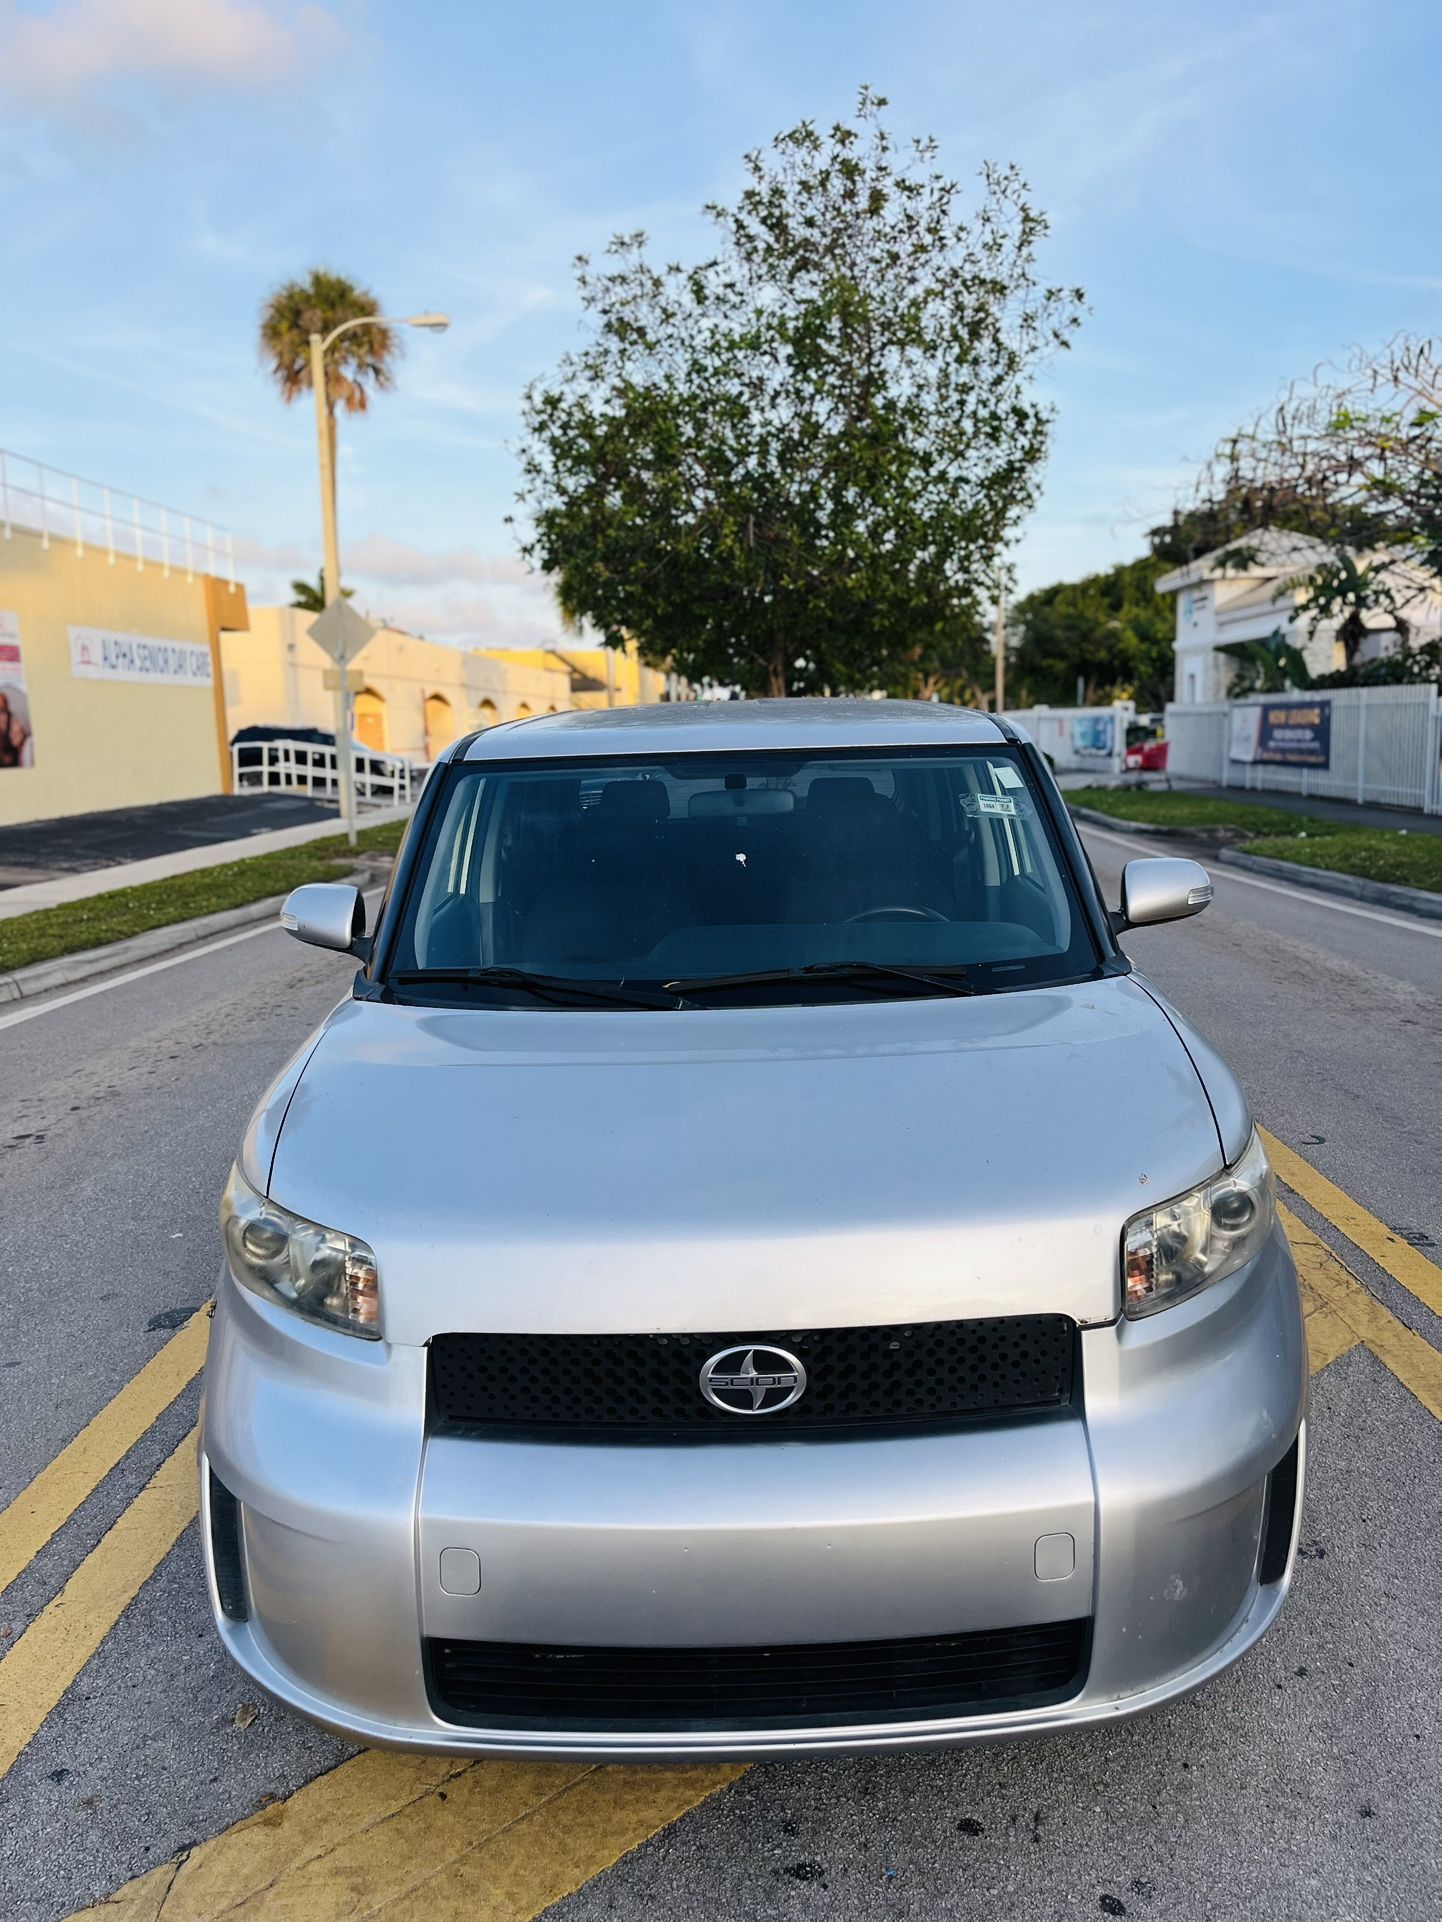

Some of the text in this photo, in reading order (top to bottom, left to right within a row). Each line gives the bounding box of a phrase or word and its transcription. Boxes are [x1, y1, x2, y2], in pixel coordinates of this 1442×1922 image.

[102, 639, 211, 678] ALPHA SENIOR DAY CARE
[708, 1376, 797, 1387] SCION
